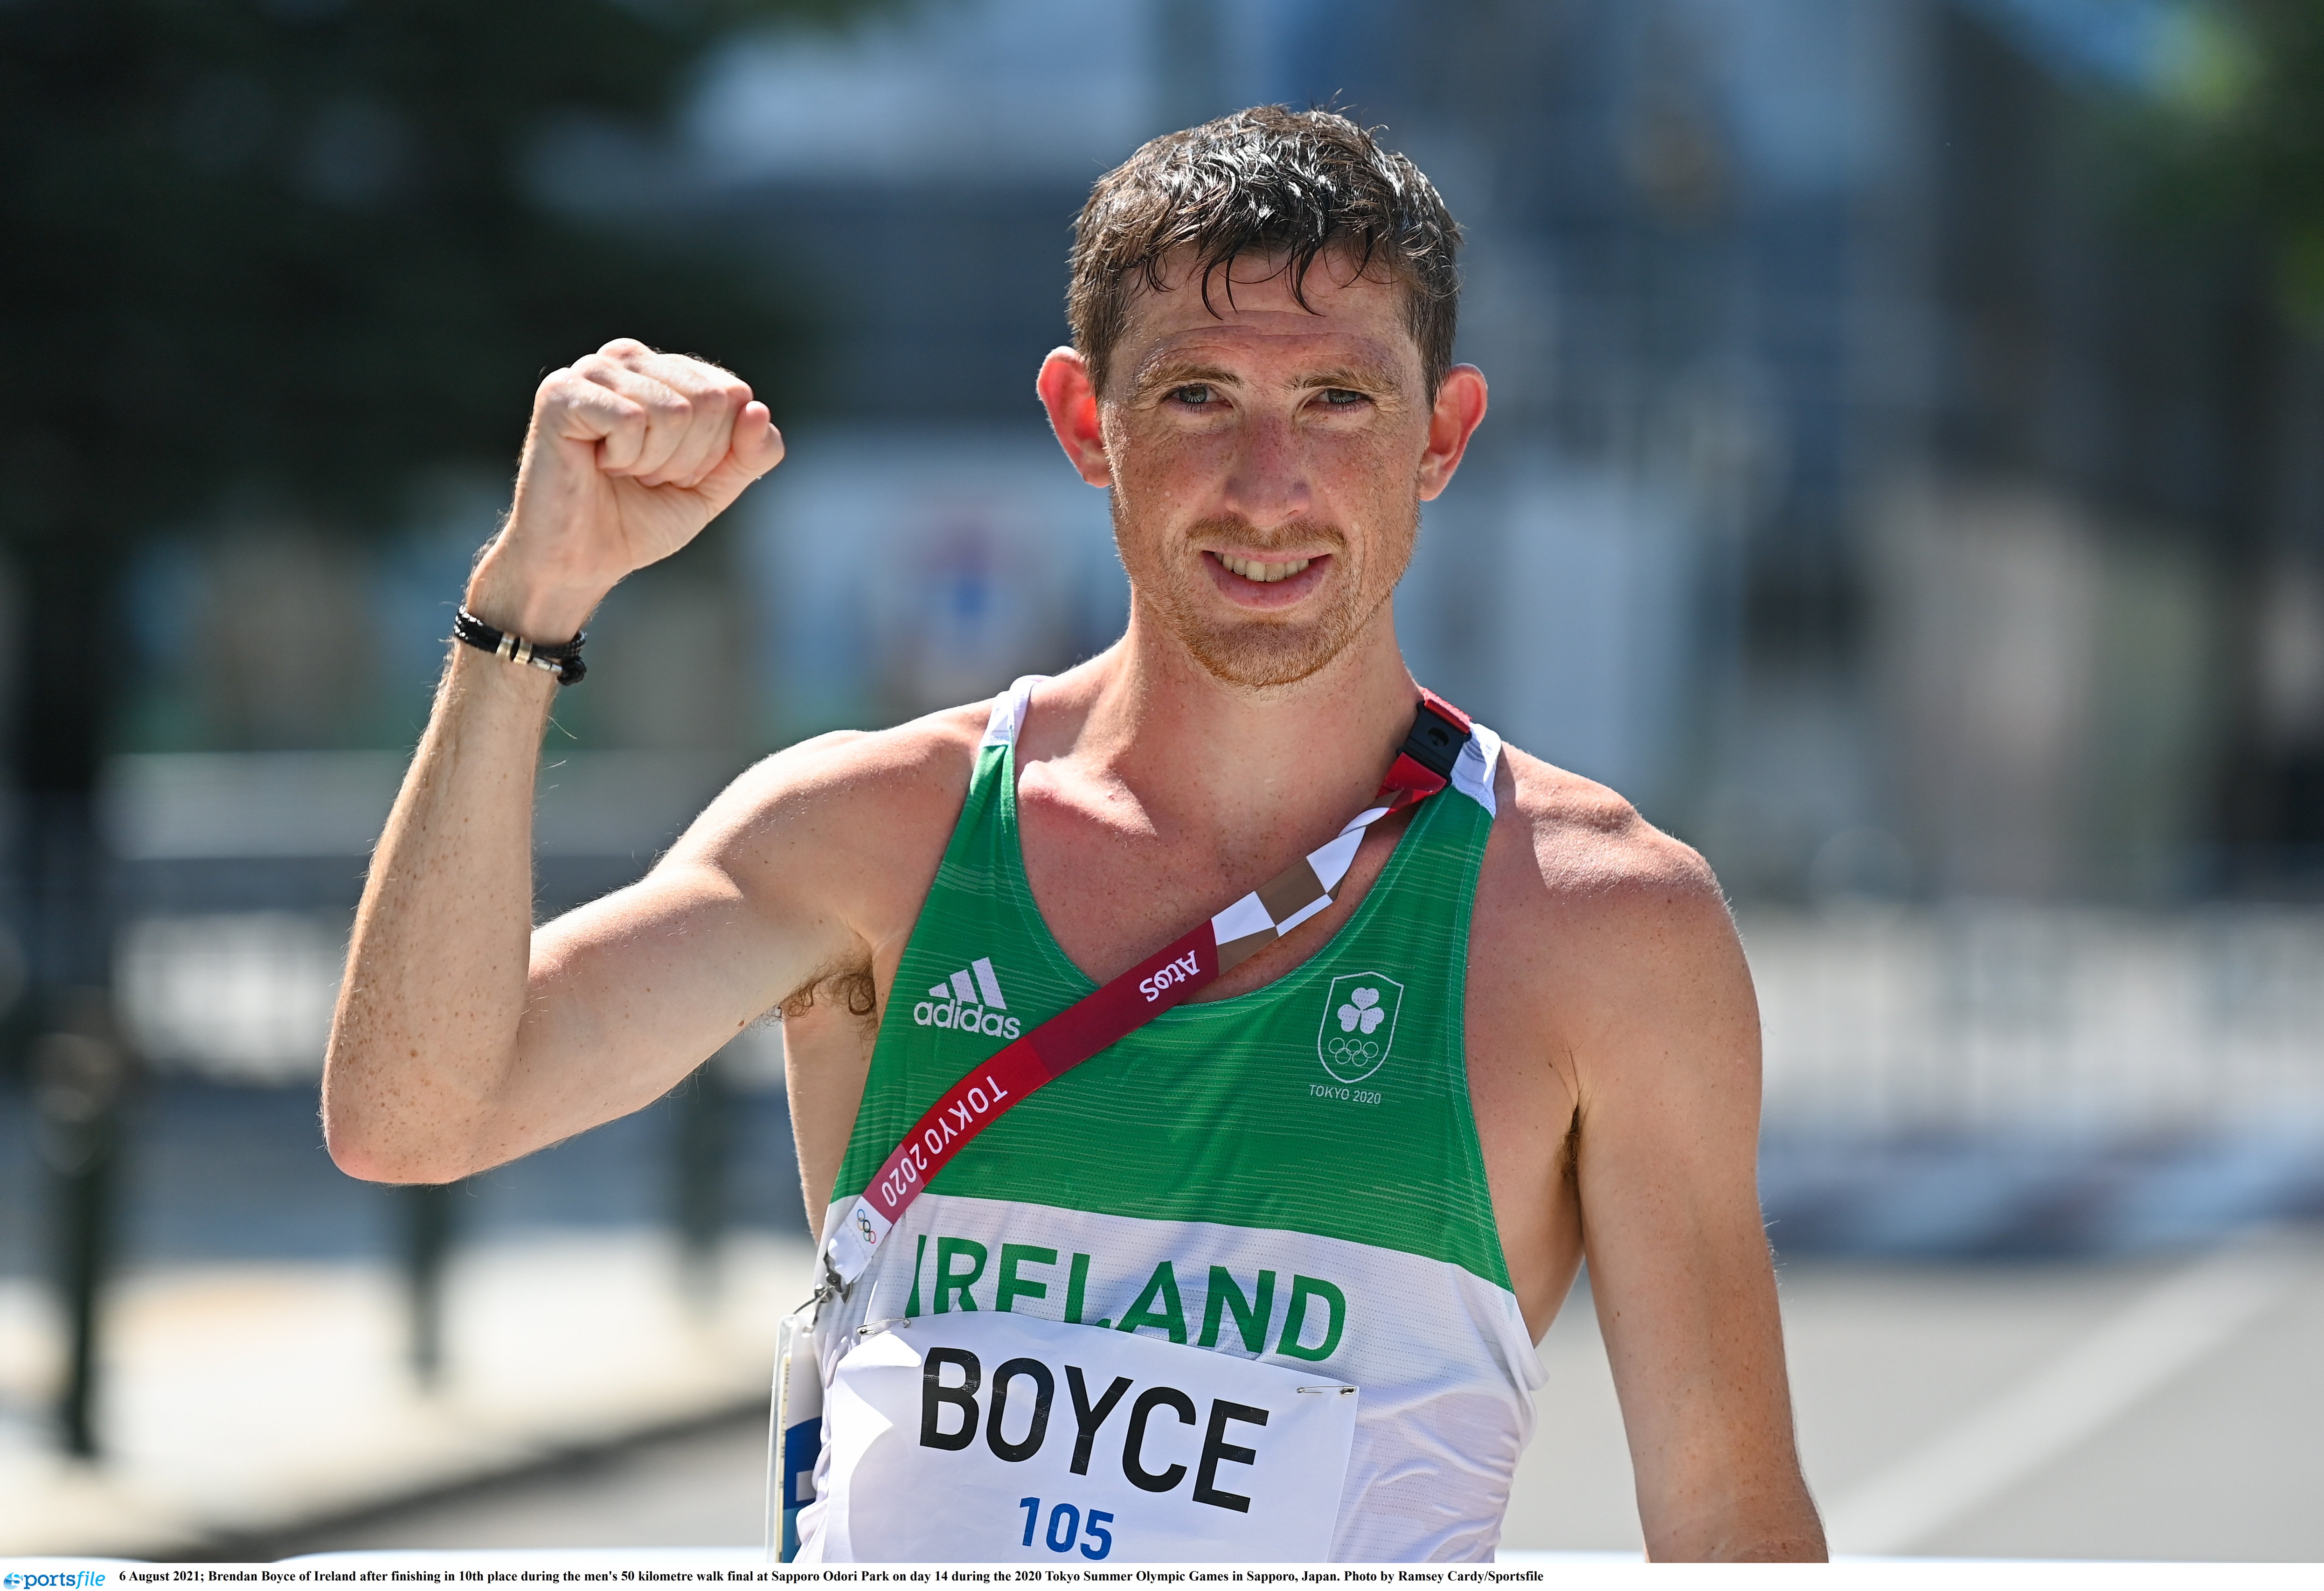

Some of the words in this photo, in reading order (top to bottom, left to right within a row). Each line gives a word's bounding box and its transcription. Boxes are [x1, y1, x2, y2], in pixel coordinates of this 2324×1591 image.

[914, 999, 1020, 1040] adidas
[924, 1076, 1008, 1154] TOKYO
[1309, 1084, 1349, 1100] TOKYO
[1353, 1090, 1381, 1104] 2020
[881, 1143, 927, 1207] 2020
[905, 1234, 1346, 1362] IRELAND
[919, 1347, 1270, 1514] BOYCE
[1019, 1497, 1114, 1561] 105
